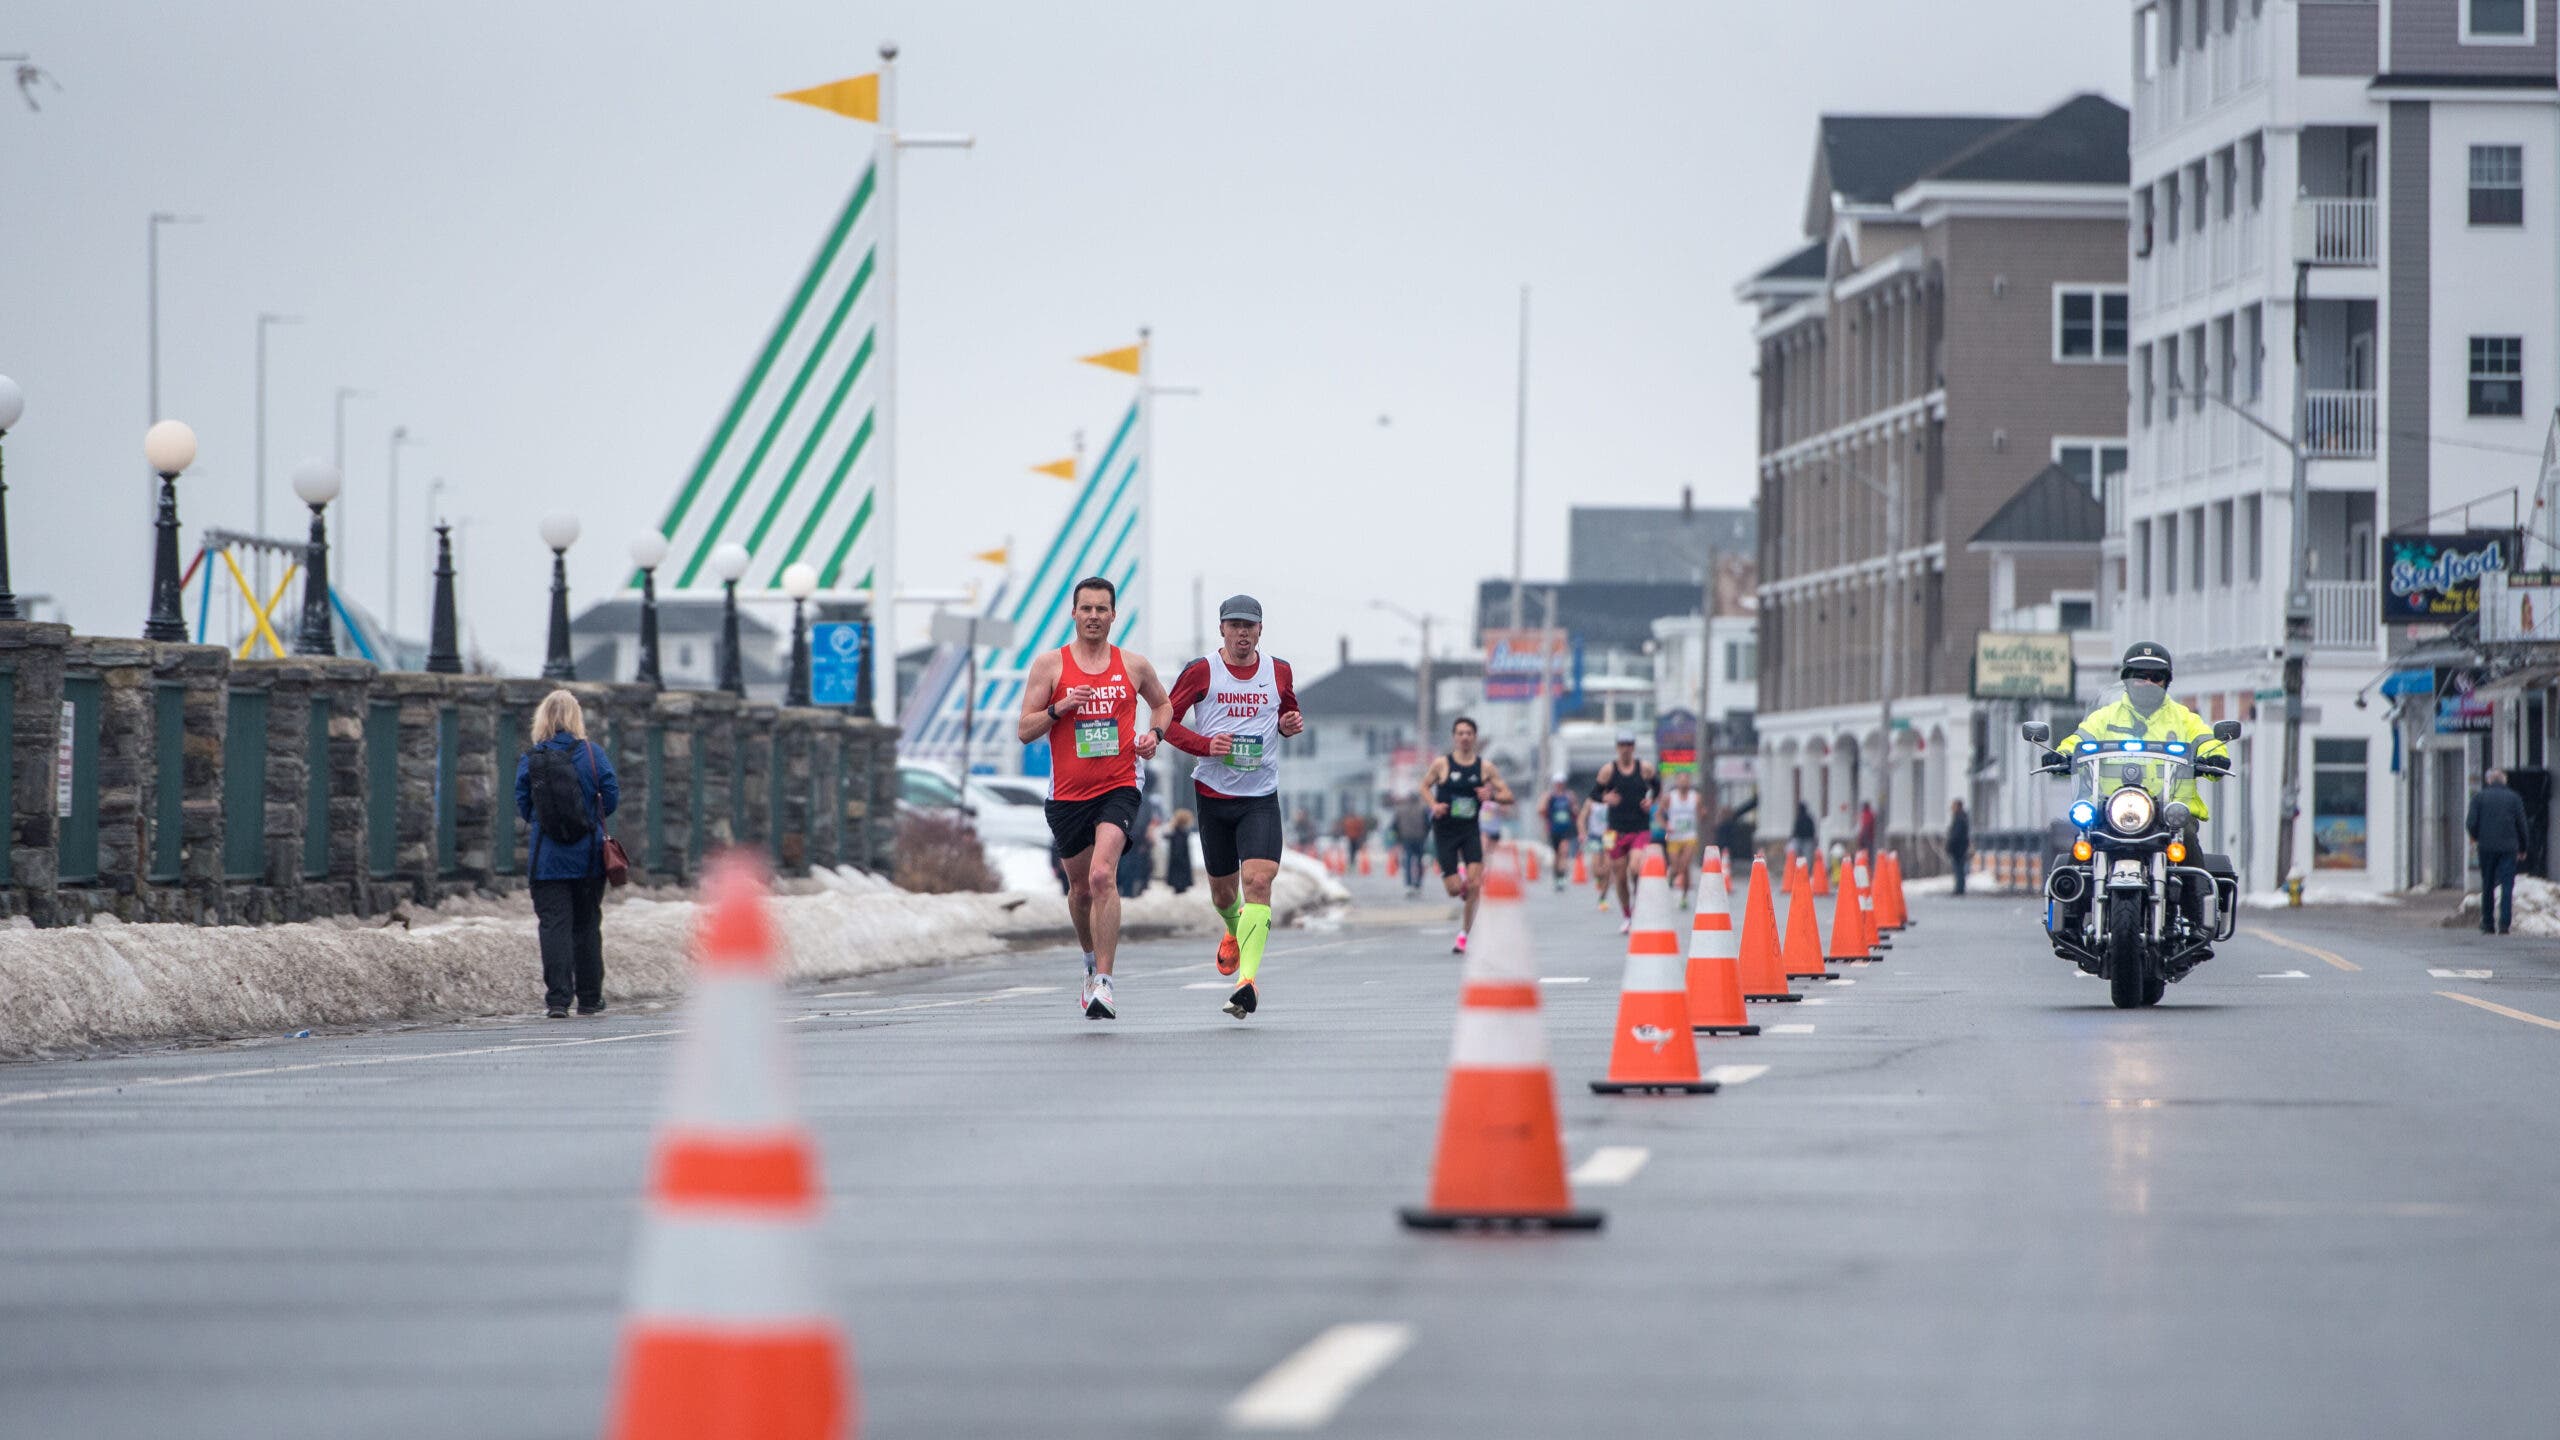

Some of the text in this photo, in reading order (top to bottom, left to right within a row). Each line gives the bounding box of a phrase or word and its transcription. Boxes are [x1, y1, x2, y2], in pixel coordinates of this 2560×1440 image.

[2391, 541, 2501, 595] Seafood
[1066, 686, 1127, 699] RNER'S
[1217, 692, 1269, 705] RUNNER'S
[1076, 700, 1115, 715] ALLEY
[1227, 706, 1259, 718] ALLEY
[1084, 727, 1109, 741] 545
[1231, 743, 1250, 756] 111
